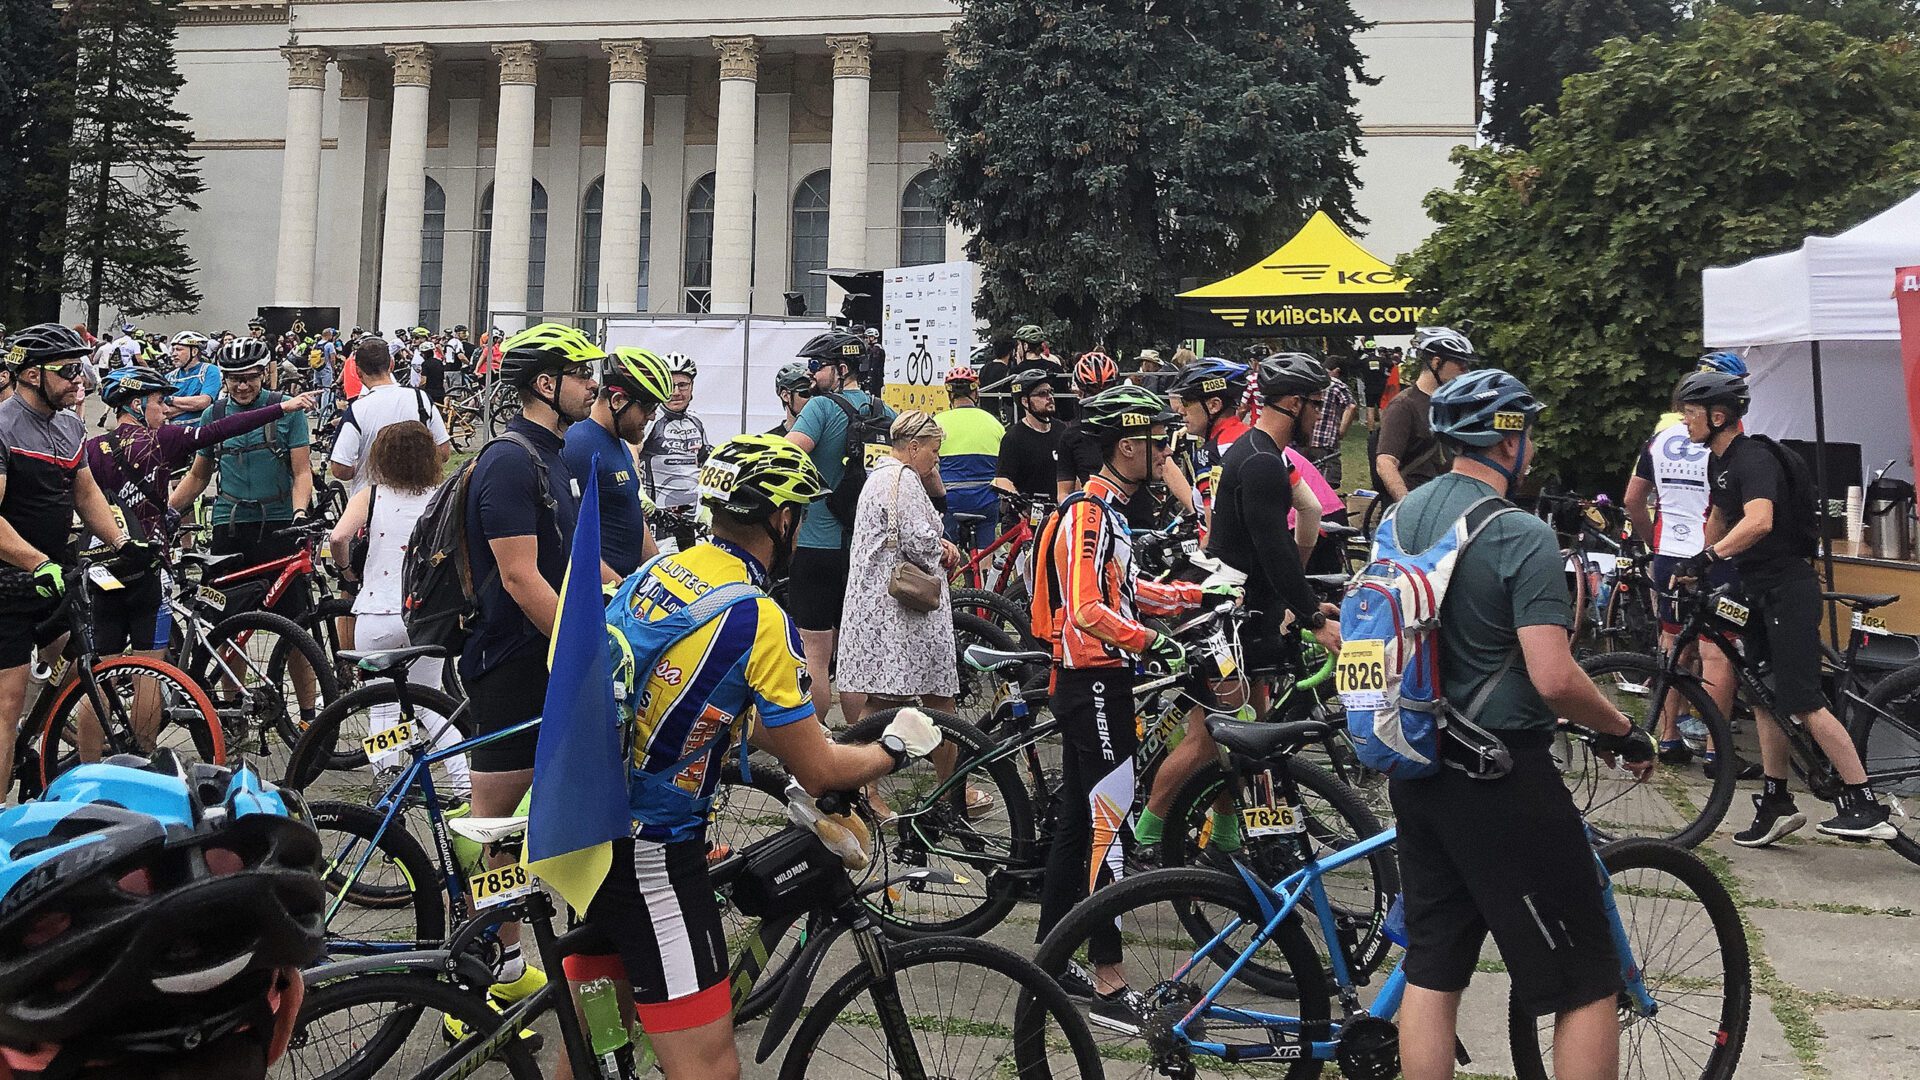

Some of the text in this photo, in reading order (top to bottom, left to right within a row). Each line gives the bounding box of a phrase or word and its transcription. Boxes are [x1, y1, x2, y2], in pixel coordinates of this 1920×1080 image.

[1256, 304, 1363, 326] КИЇВСЬКА
[121, 377, 142, 389] 2066
[1204, 380, 1226, 392] 2085
[724, 504, 750, 514] LAZER
[200, 587, 226, 606] 2066
[1719, 601, 1748, 621] 2084
[1338, 661, 1383, 691] 7826
[1093, 696, 1116, 761] INBIKE
[1155, 706, 1185, 741] 2116
[364, 725, 410, 754] 7813
[1245, 810, 1294, 828] 7826
[472, 865, 527, 898] 7858
[774, 861, 809, 885] WILD MAN
[1272, 1045, 1302, 1057] XTR
